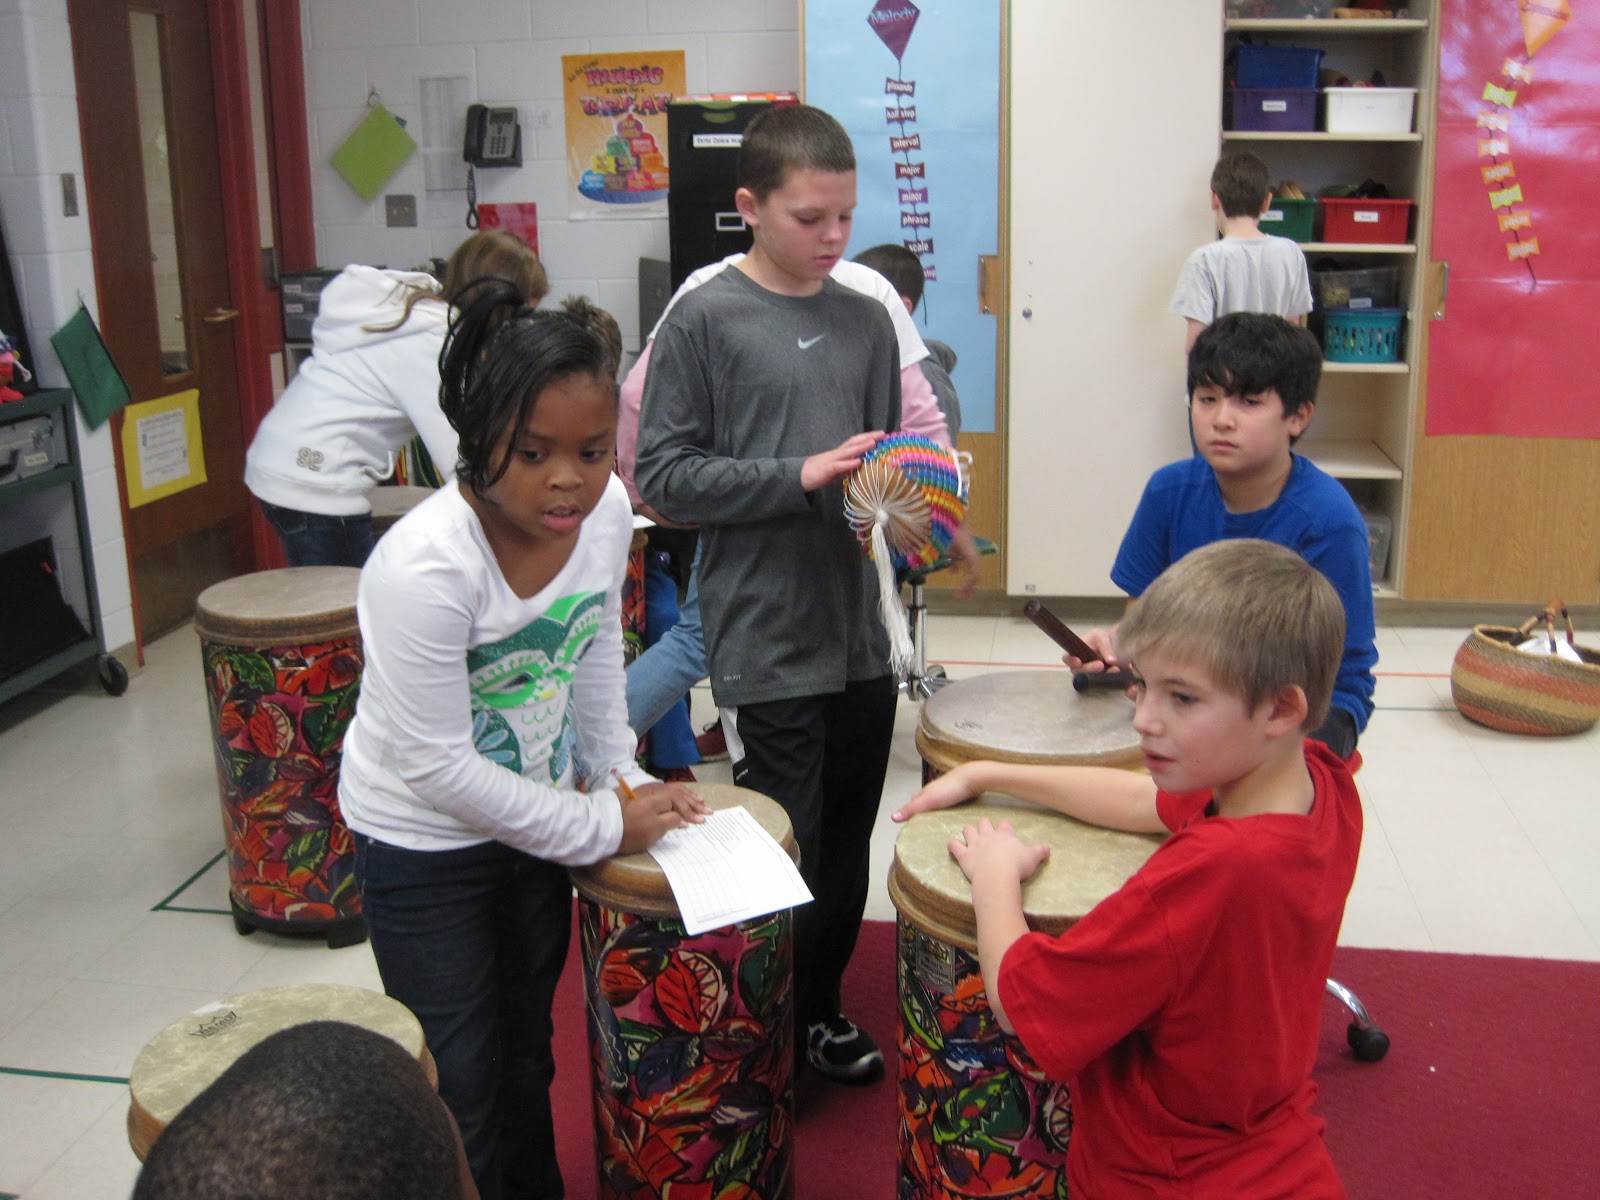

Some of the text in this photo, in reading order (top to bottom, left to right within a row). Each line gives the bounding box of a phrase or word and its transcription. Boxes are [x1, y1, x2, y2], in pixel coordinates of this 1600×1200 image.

[870, 7, 917, 24] Melody
[580, 92, 672, 116] TREAT
[887, 108, 915, 120] half step
[892, 137, 919, 148] interval
[899, 165, 921, 176] major
[901, 191, 922, 202] minor
[902, 215, 929, 226] phrase
[908, 241, 929, 252] scale
